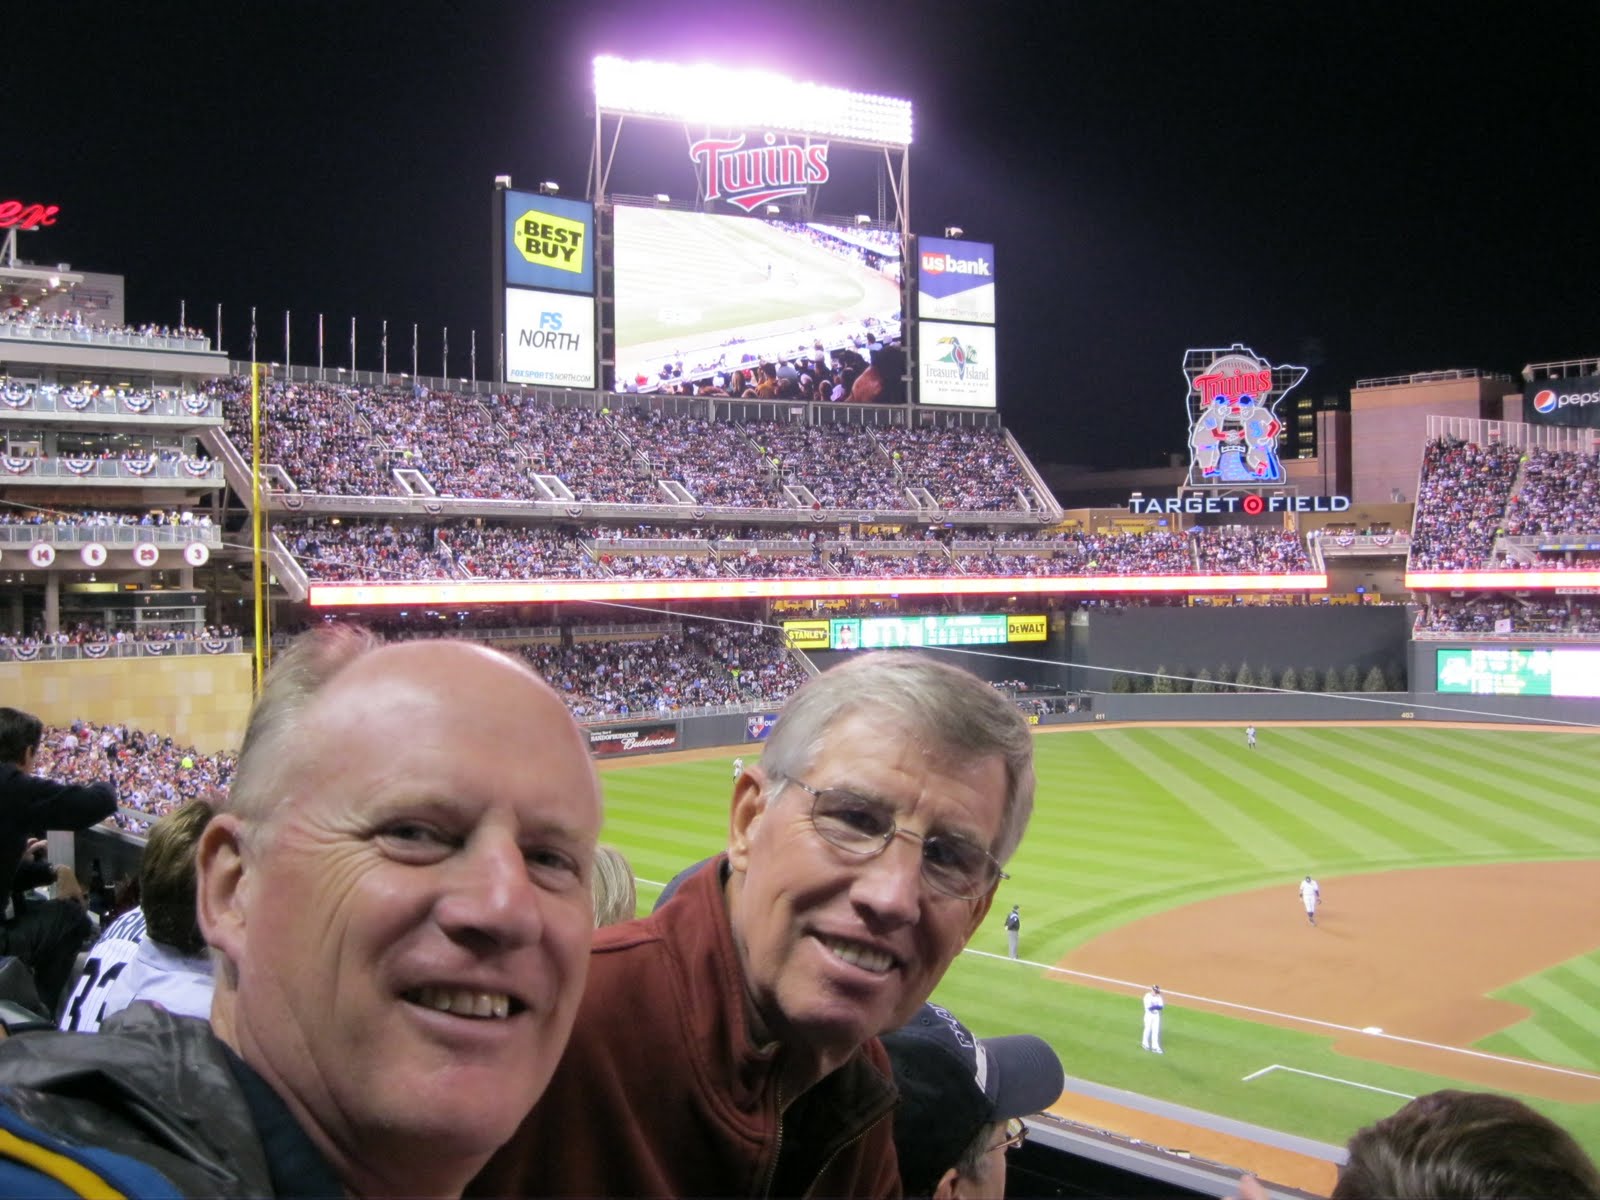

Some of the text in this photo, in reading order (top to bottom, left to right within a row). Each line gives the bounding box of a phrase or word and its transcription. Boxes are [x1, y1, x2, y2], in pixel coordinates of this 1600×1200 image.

[690, 132, 829, 202] Twins
[524, 219, 582, 247] BEST
[525, 237, 577, 262] BUY
[540, 311, 563, 331] FS
[519, 328, 580, 351] NORTH
[925, 363, 989, 381] Treasure Island
[1193, 370, 1273, 407] Twins
[1130, 495, 1350, 514] TARGET FIELD
[788, 630, 825, 640] STANLEY
[621, 736, 676, 750] Budweiser
